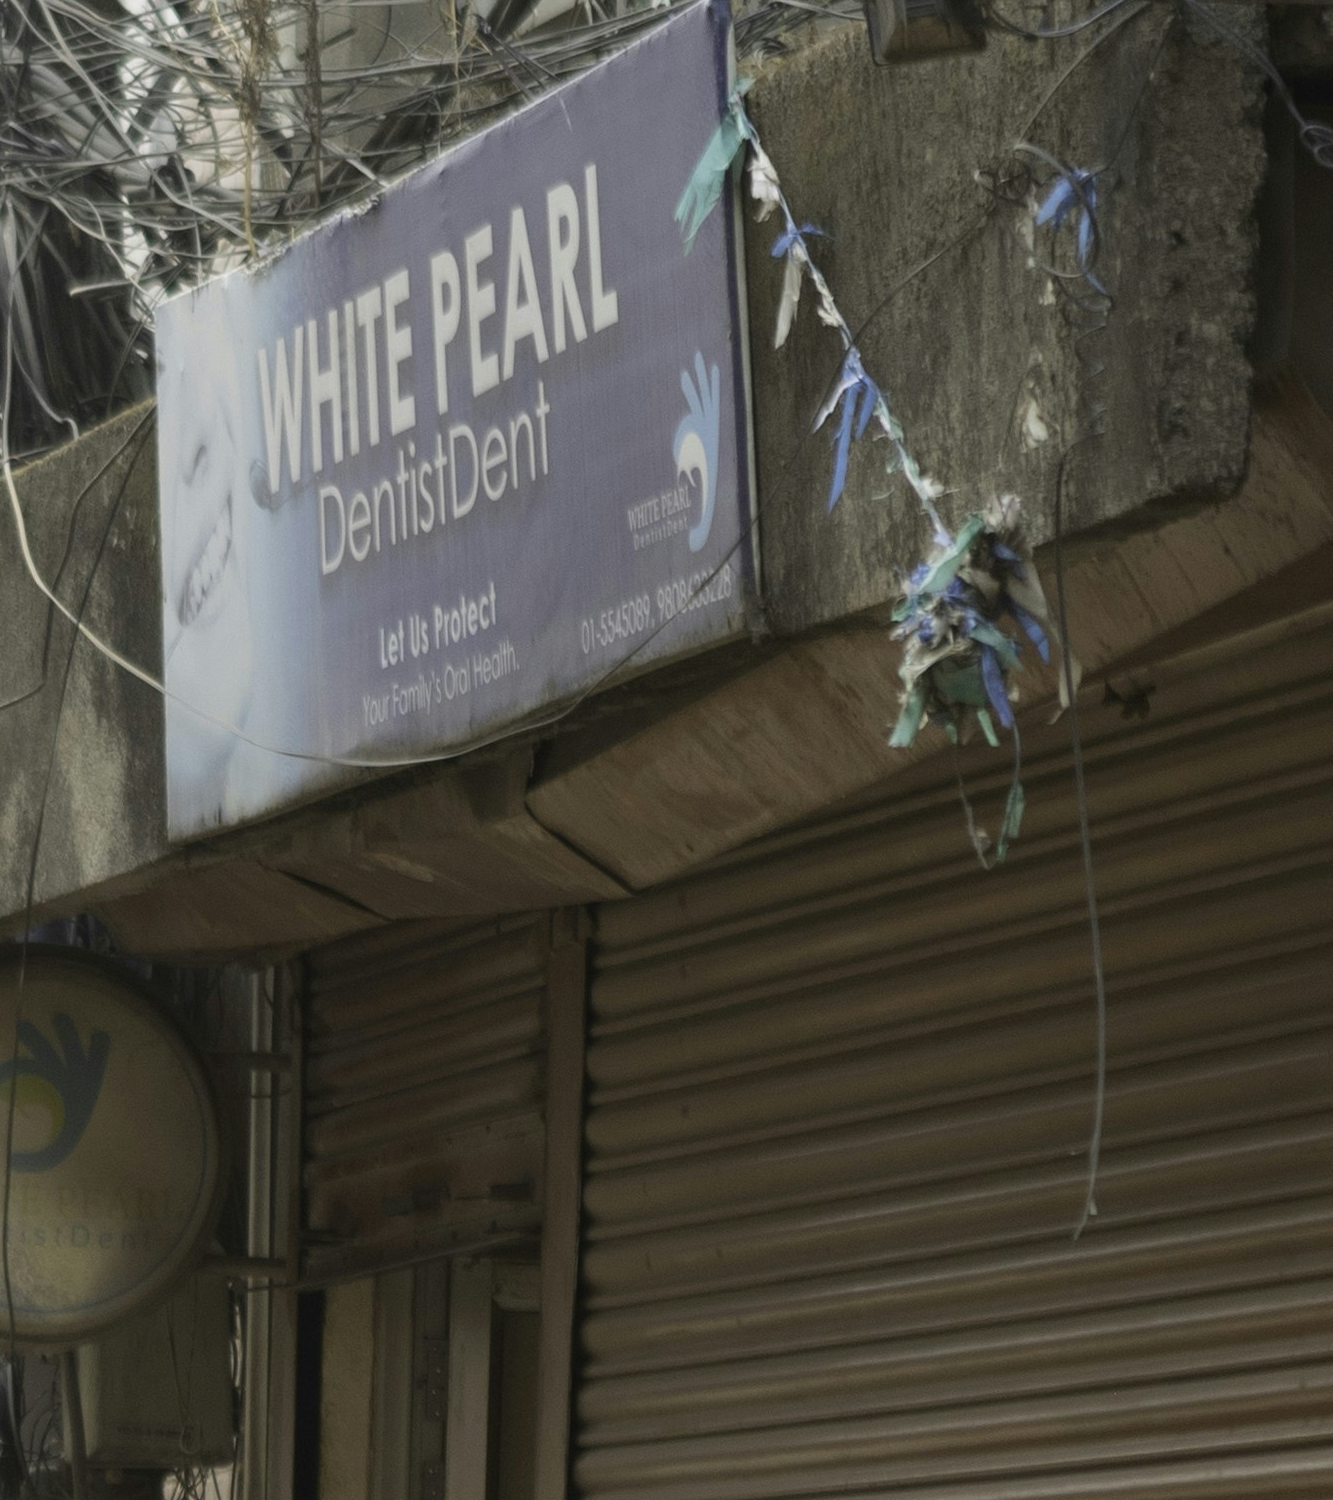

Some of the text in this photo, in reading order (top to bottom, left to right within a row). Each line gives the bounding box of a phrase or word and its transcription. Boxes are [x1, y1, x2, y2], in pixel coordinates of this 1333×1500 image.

[257, 162, 620, 496] WHITE PEARL
[317, 378, 552, 577] DentistDent
[626, 484, 692, 533] WHITE PEARL
[380, 580, 496, 670] Let Us Protect
[363, 638, 521, 728] Your Family's Oral Health.
